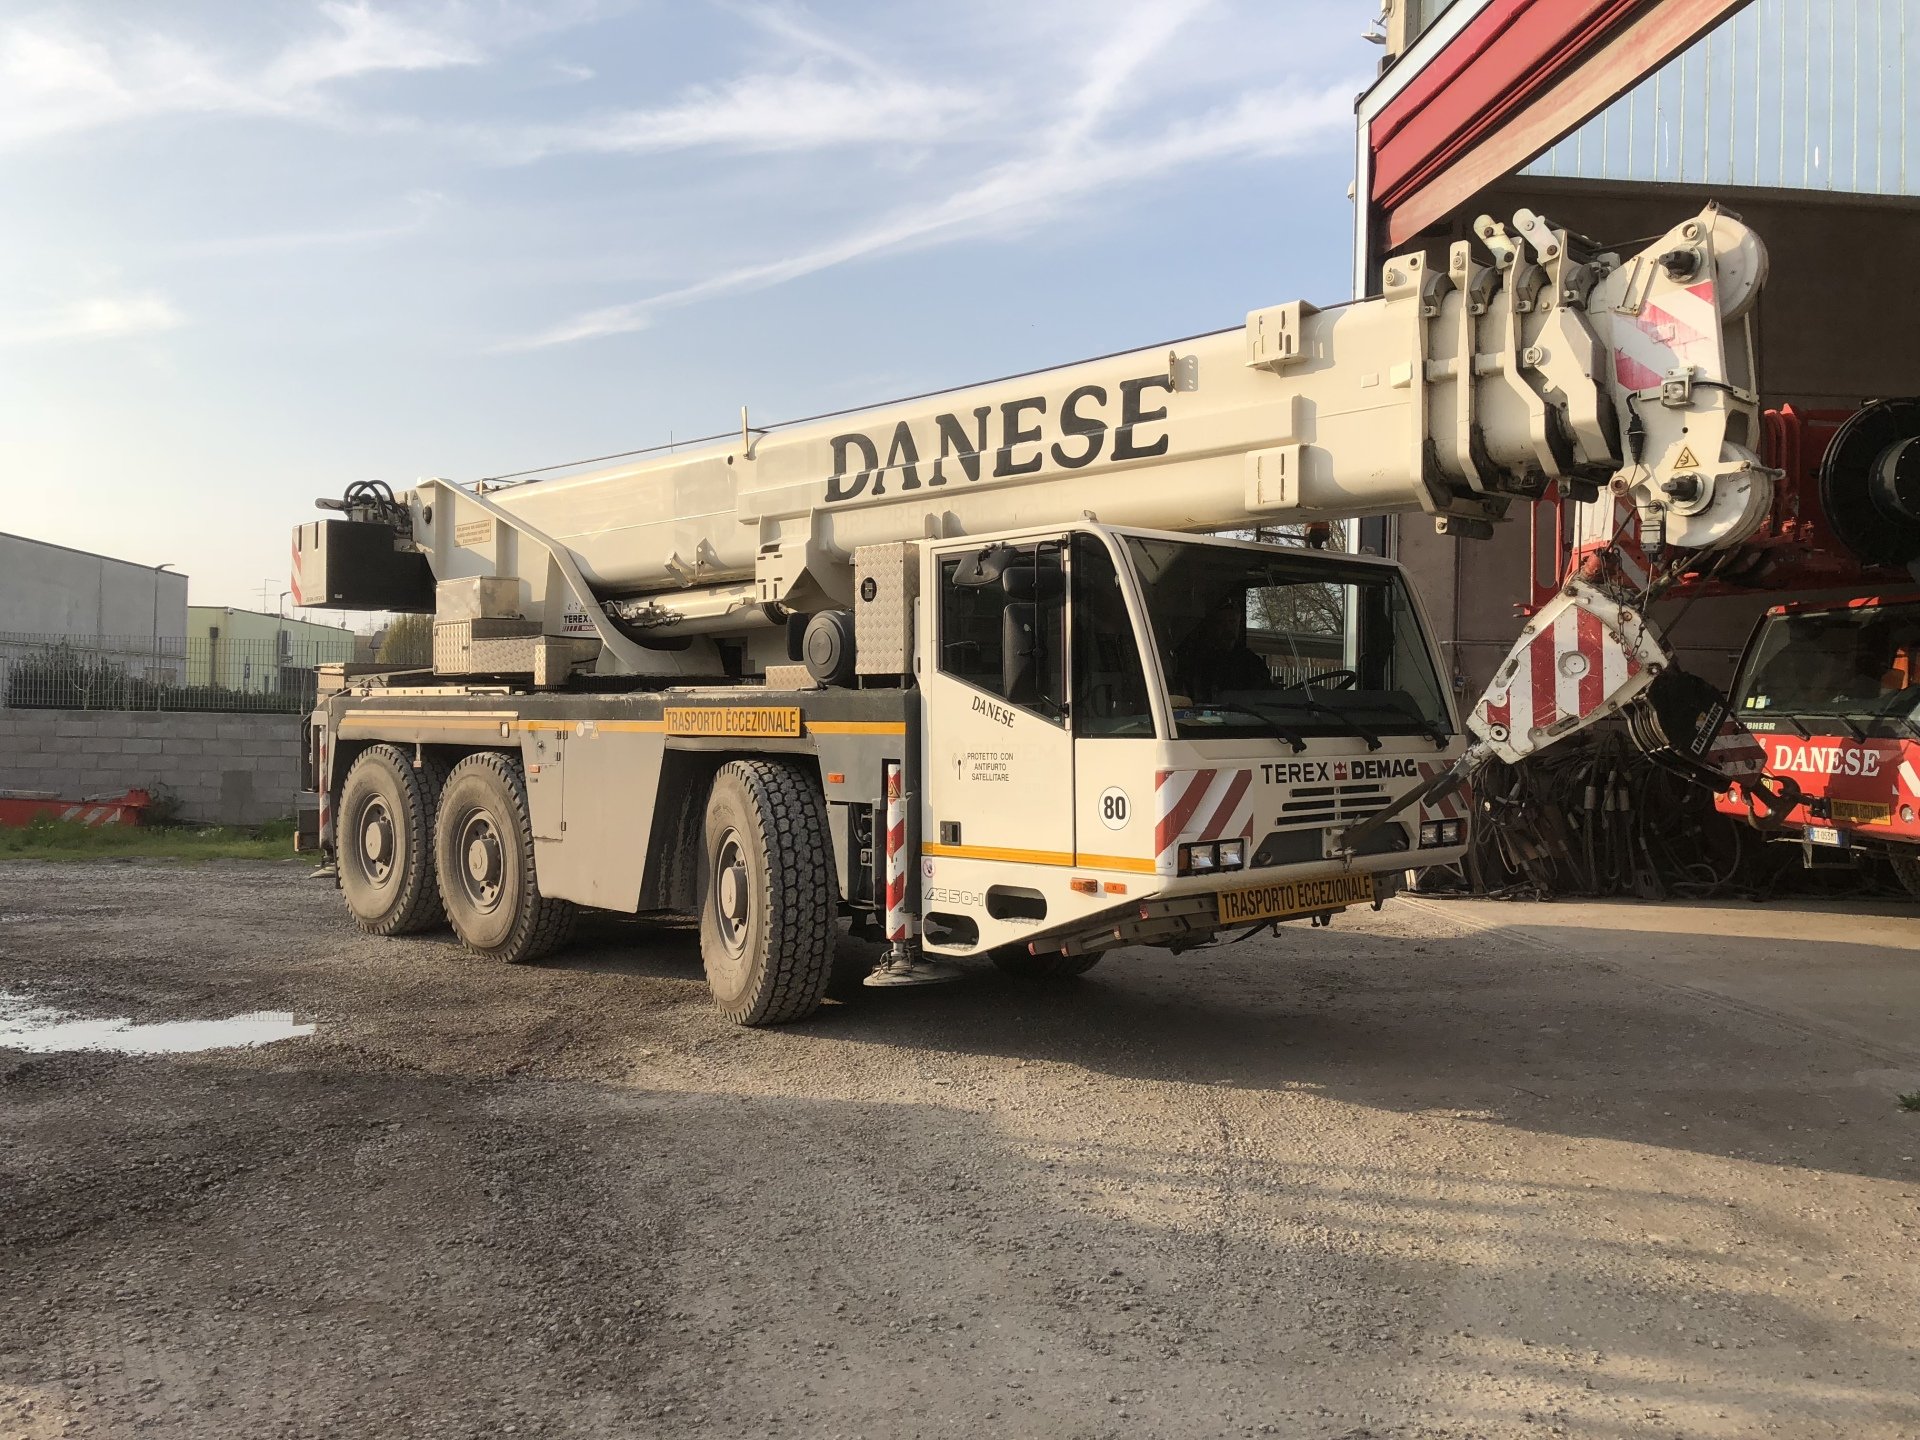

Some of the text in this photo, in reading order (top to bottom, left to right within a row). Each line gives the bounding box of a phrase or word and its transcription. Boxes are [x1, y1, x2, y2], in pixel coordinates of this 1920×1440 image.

[824, 373, 1175, 502] DANESE
[563, 615, 589, 623] TEREX
[666, 711, 796, 732] TRASPORTO ECCEZIONALE
[972, 695, 1016, 728] DANESE
[967, 752, 998, 760] PROTETTO
[1000, 752, 1014, 761] CON
[974, 763, 1007, 771] ANTIFURTO
[1773, 745, 1881, 777] DANESE
[971, 773, 1010, 782] SATELLITARE
[1260, 758, 1418, 784] TEREX DEMAG
[1104, 795, 1126, 820] 80
[1222, 875, 1372, 919] TRASPORTO ECCEZIONALE
